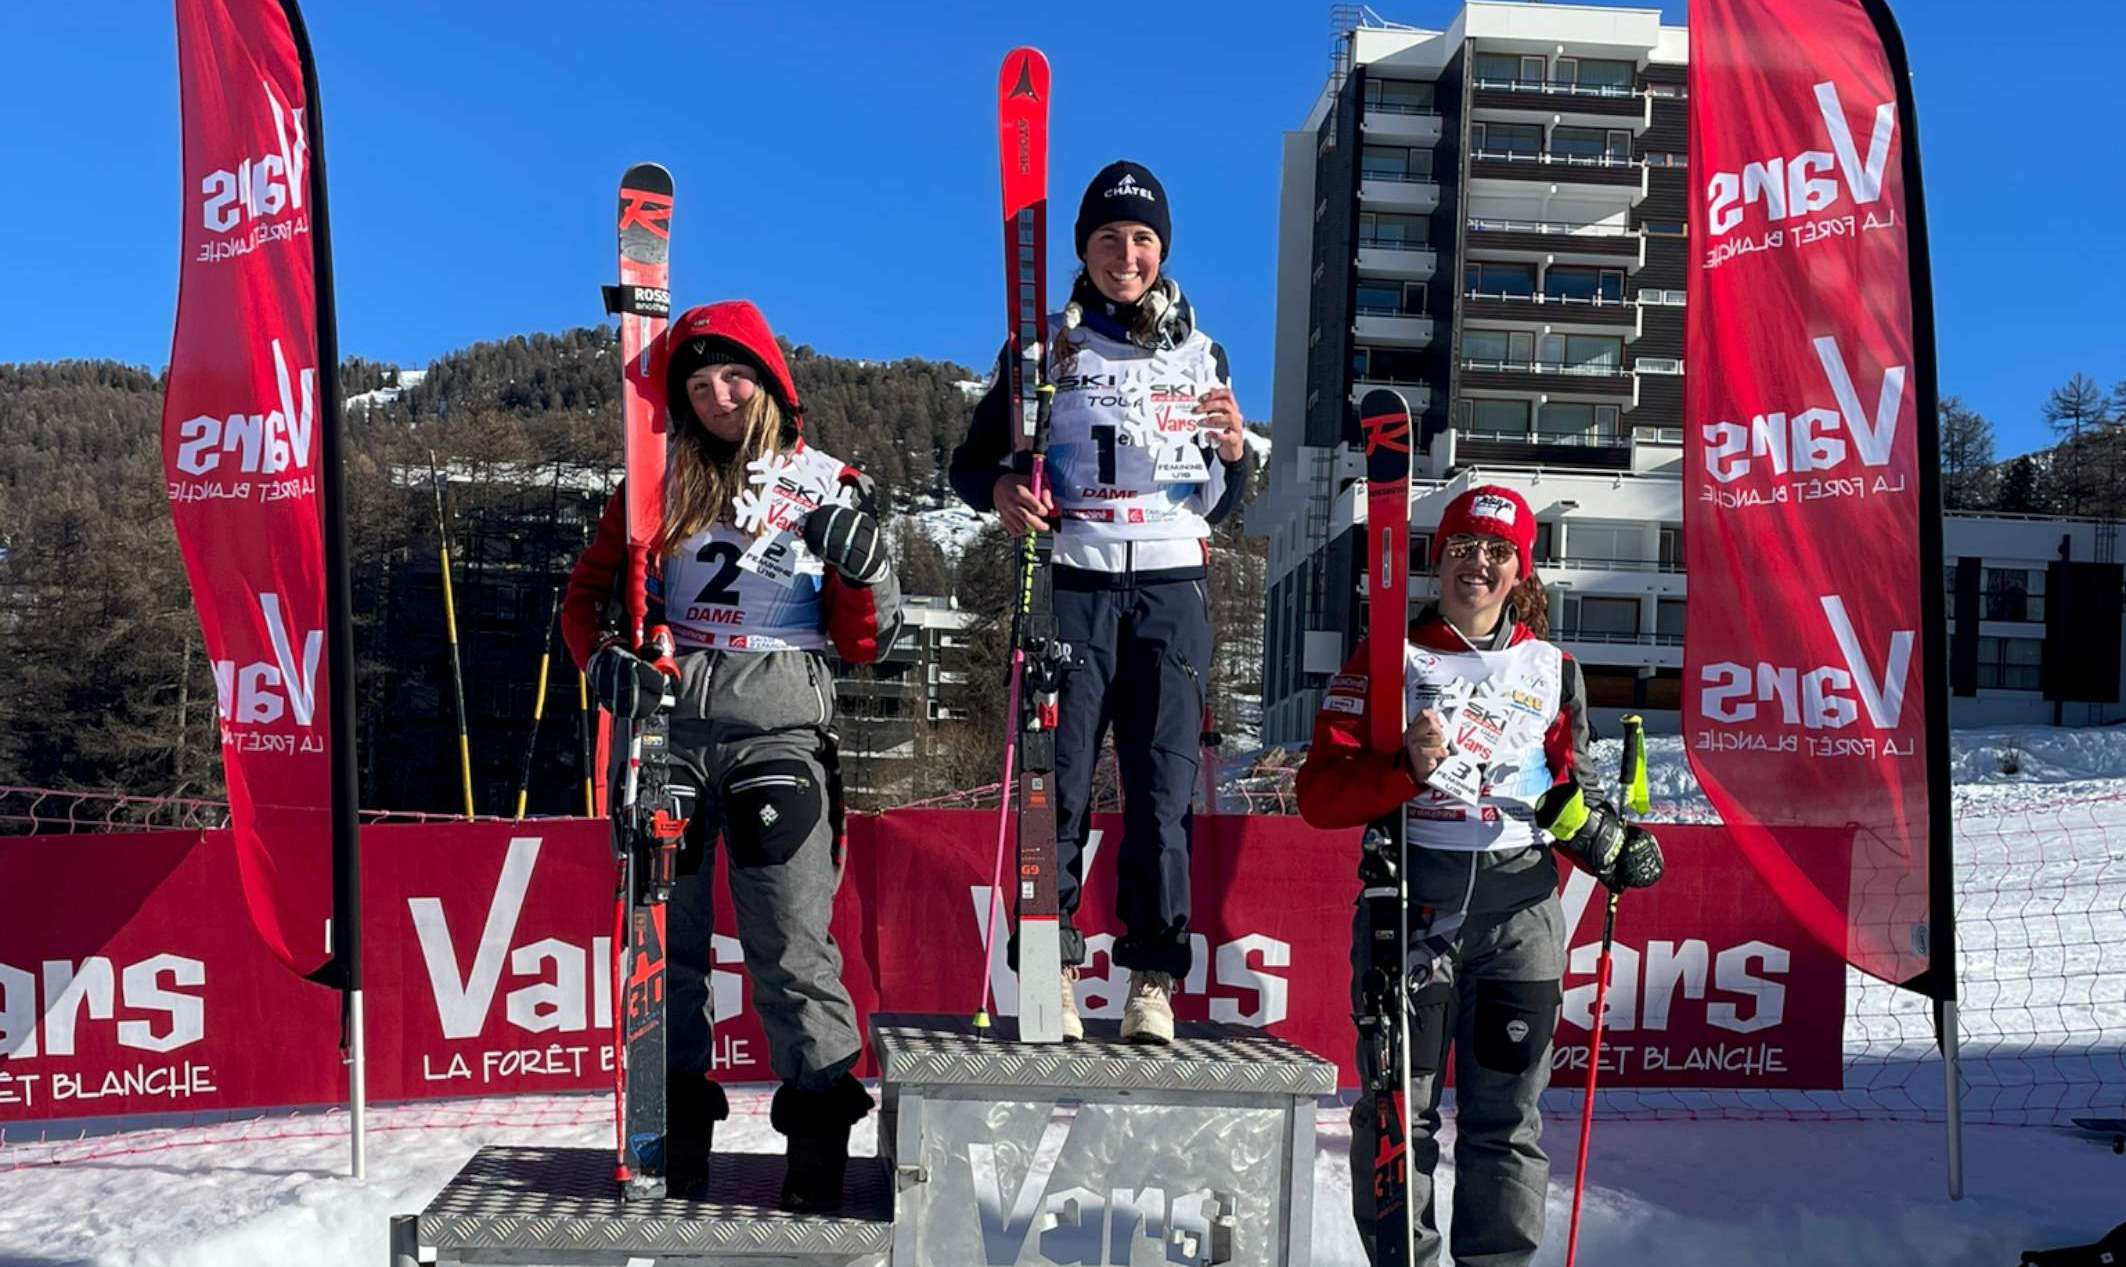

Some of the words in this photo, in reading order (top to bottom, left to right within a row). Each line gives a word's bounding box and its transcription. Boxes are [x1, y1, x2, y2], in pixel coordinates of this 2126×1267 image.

[634, 286, 671, 304] ROSS
[1056, 374, 1116, 391] SKI
[1150, 384, 1195, 397] SKI
[1155, 405, 1198, 433] Vars
[1175, 445, 1185, 463] 1
[775, 476, 824, 506] SKI
[1082, 487, 1139, 499] DAME
[763, 542, 787, 563] 2
[691, 541, 743, 606] 2
[686, 607, 746, 625] DAME
[1467, 701, 1508, 732] SKI
[1456, 726, 1492, 760] Vars
[1451, 761, 1472, 780] 3
[1429, 784, 1495, 801] DE
[1561, 866, 1791, 1034] ars
[423, 1053, 473, 1081] LA
[483, 1043, 588, 1084] FORÊT
[1551, 1041, 1635, 1076] ORÊT
[1643, 1043, 1788, 1076] BLANCHE
[52, 1059, 217, 1100] BLANCHE
